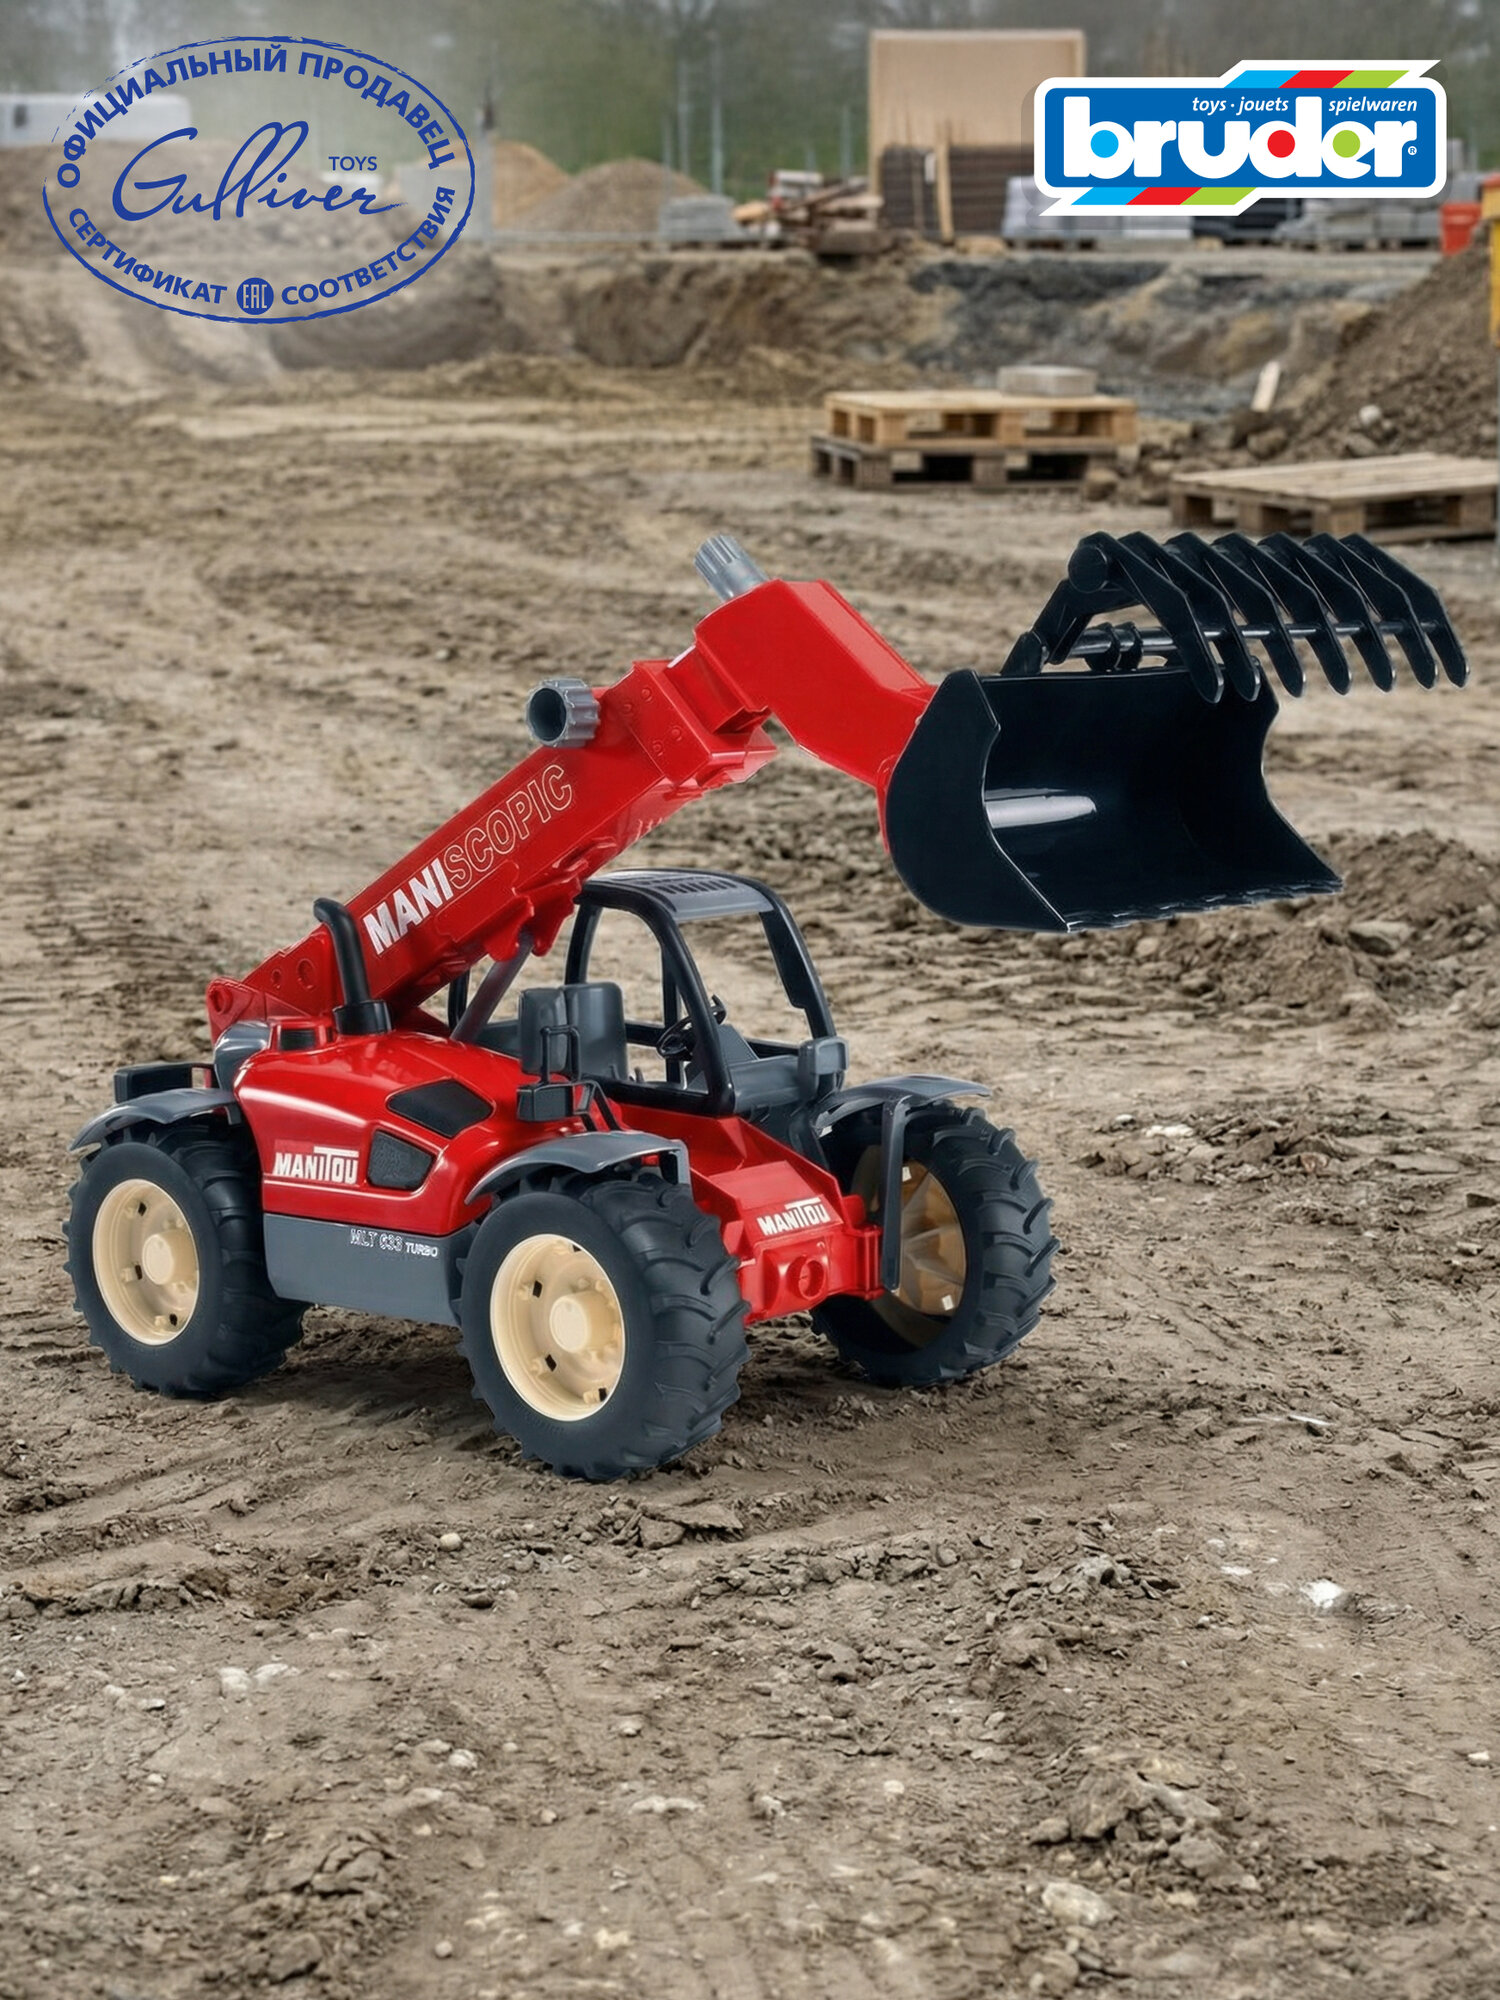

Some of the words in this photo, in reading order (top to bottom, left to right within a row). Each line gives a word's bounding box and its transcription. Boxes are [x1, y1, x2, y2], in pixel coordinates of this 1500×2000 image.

[362, 764, 573, 955] MANISCOPIC
[273, 1147, 359, 1184] MANITOU
[757, 1197, 831, 1235] MANITOU
[404, 1242, 439, 1258] TURBO
